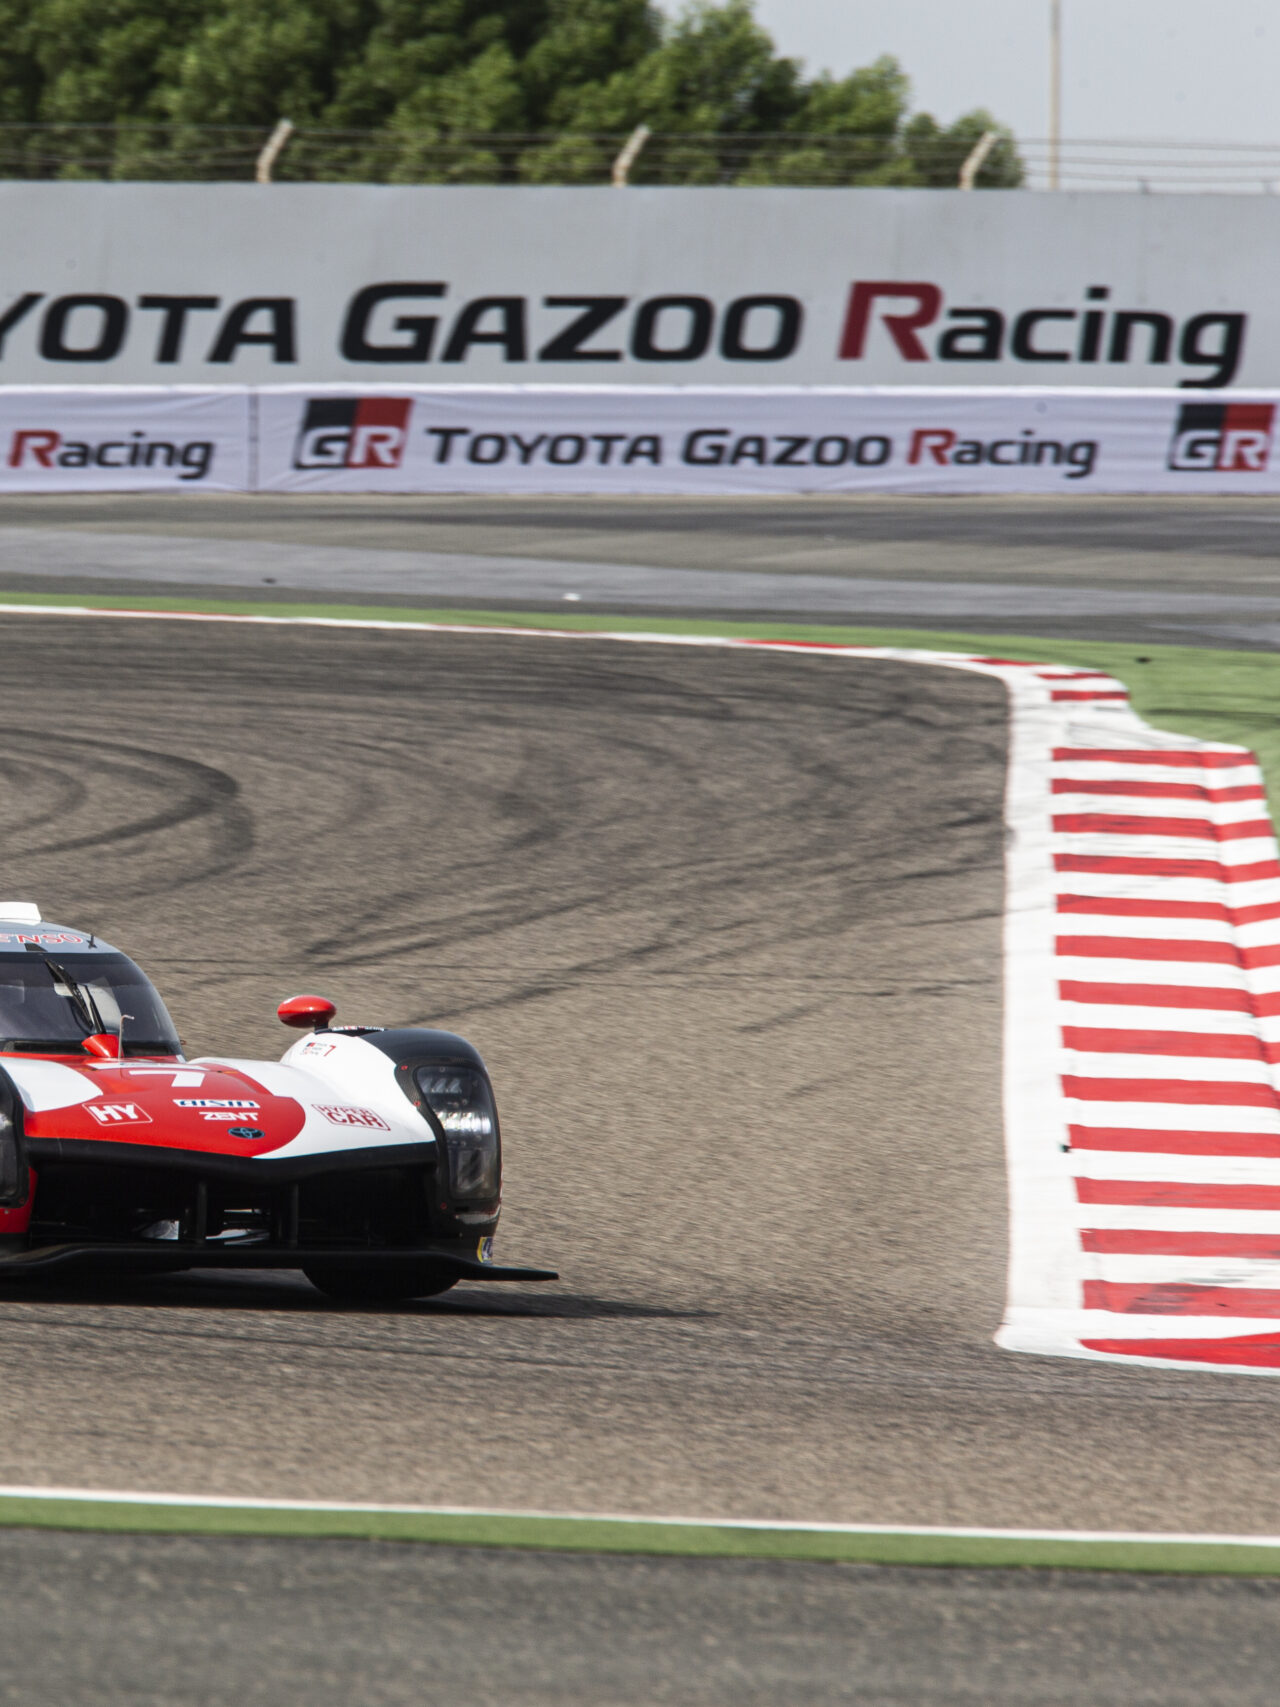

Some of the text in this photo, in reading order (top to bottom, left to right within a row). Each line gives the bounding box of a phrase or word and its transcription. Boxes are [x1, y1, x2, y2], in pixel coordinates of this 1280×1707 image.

[337, 280, 806, 365] GAZOO
[837, 280, 1248, 388] Racing
[7, 429, 216, 481] Racing
[300, 425, 1099, 480] GR TOYOTA GAZOO Racing
[1172, 429, 1266, 469] GR
[128, 1069, 206, 1087] 7
[88, 1104, 139, 1122] HY
[198, 1111, 259, 1121] ZENT
[327, 1112, 384, 1128] CAR
